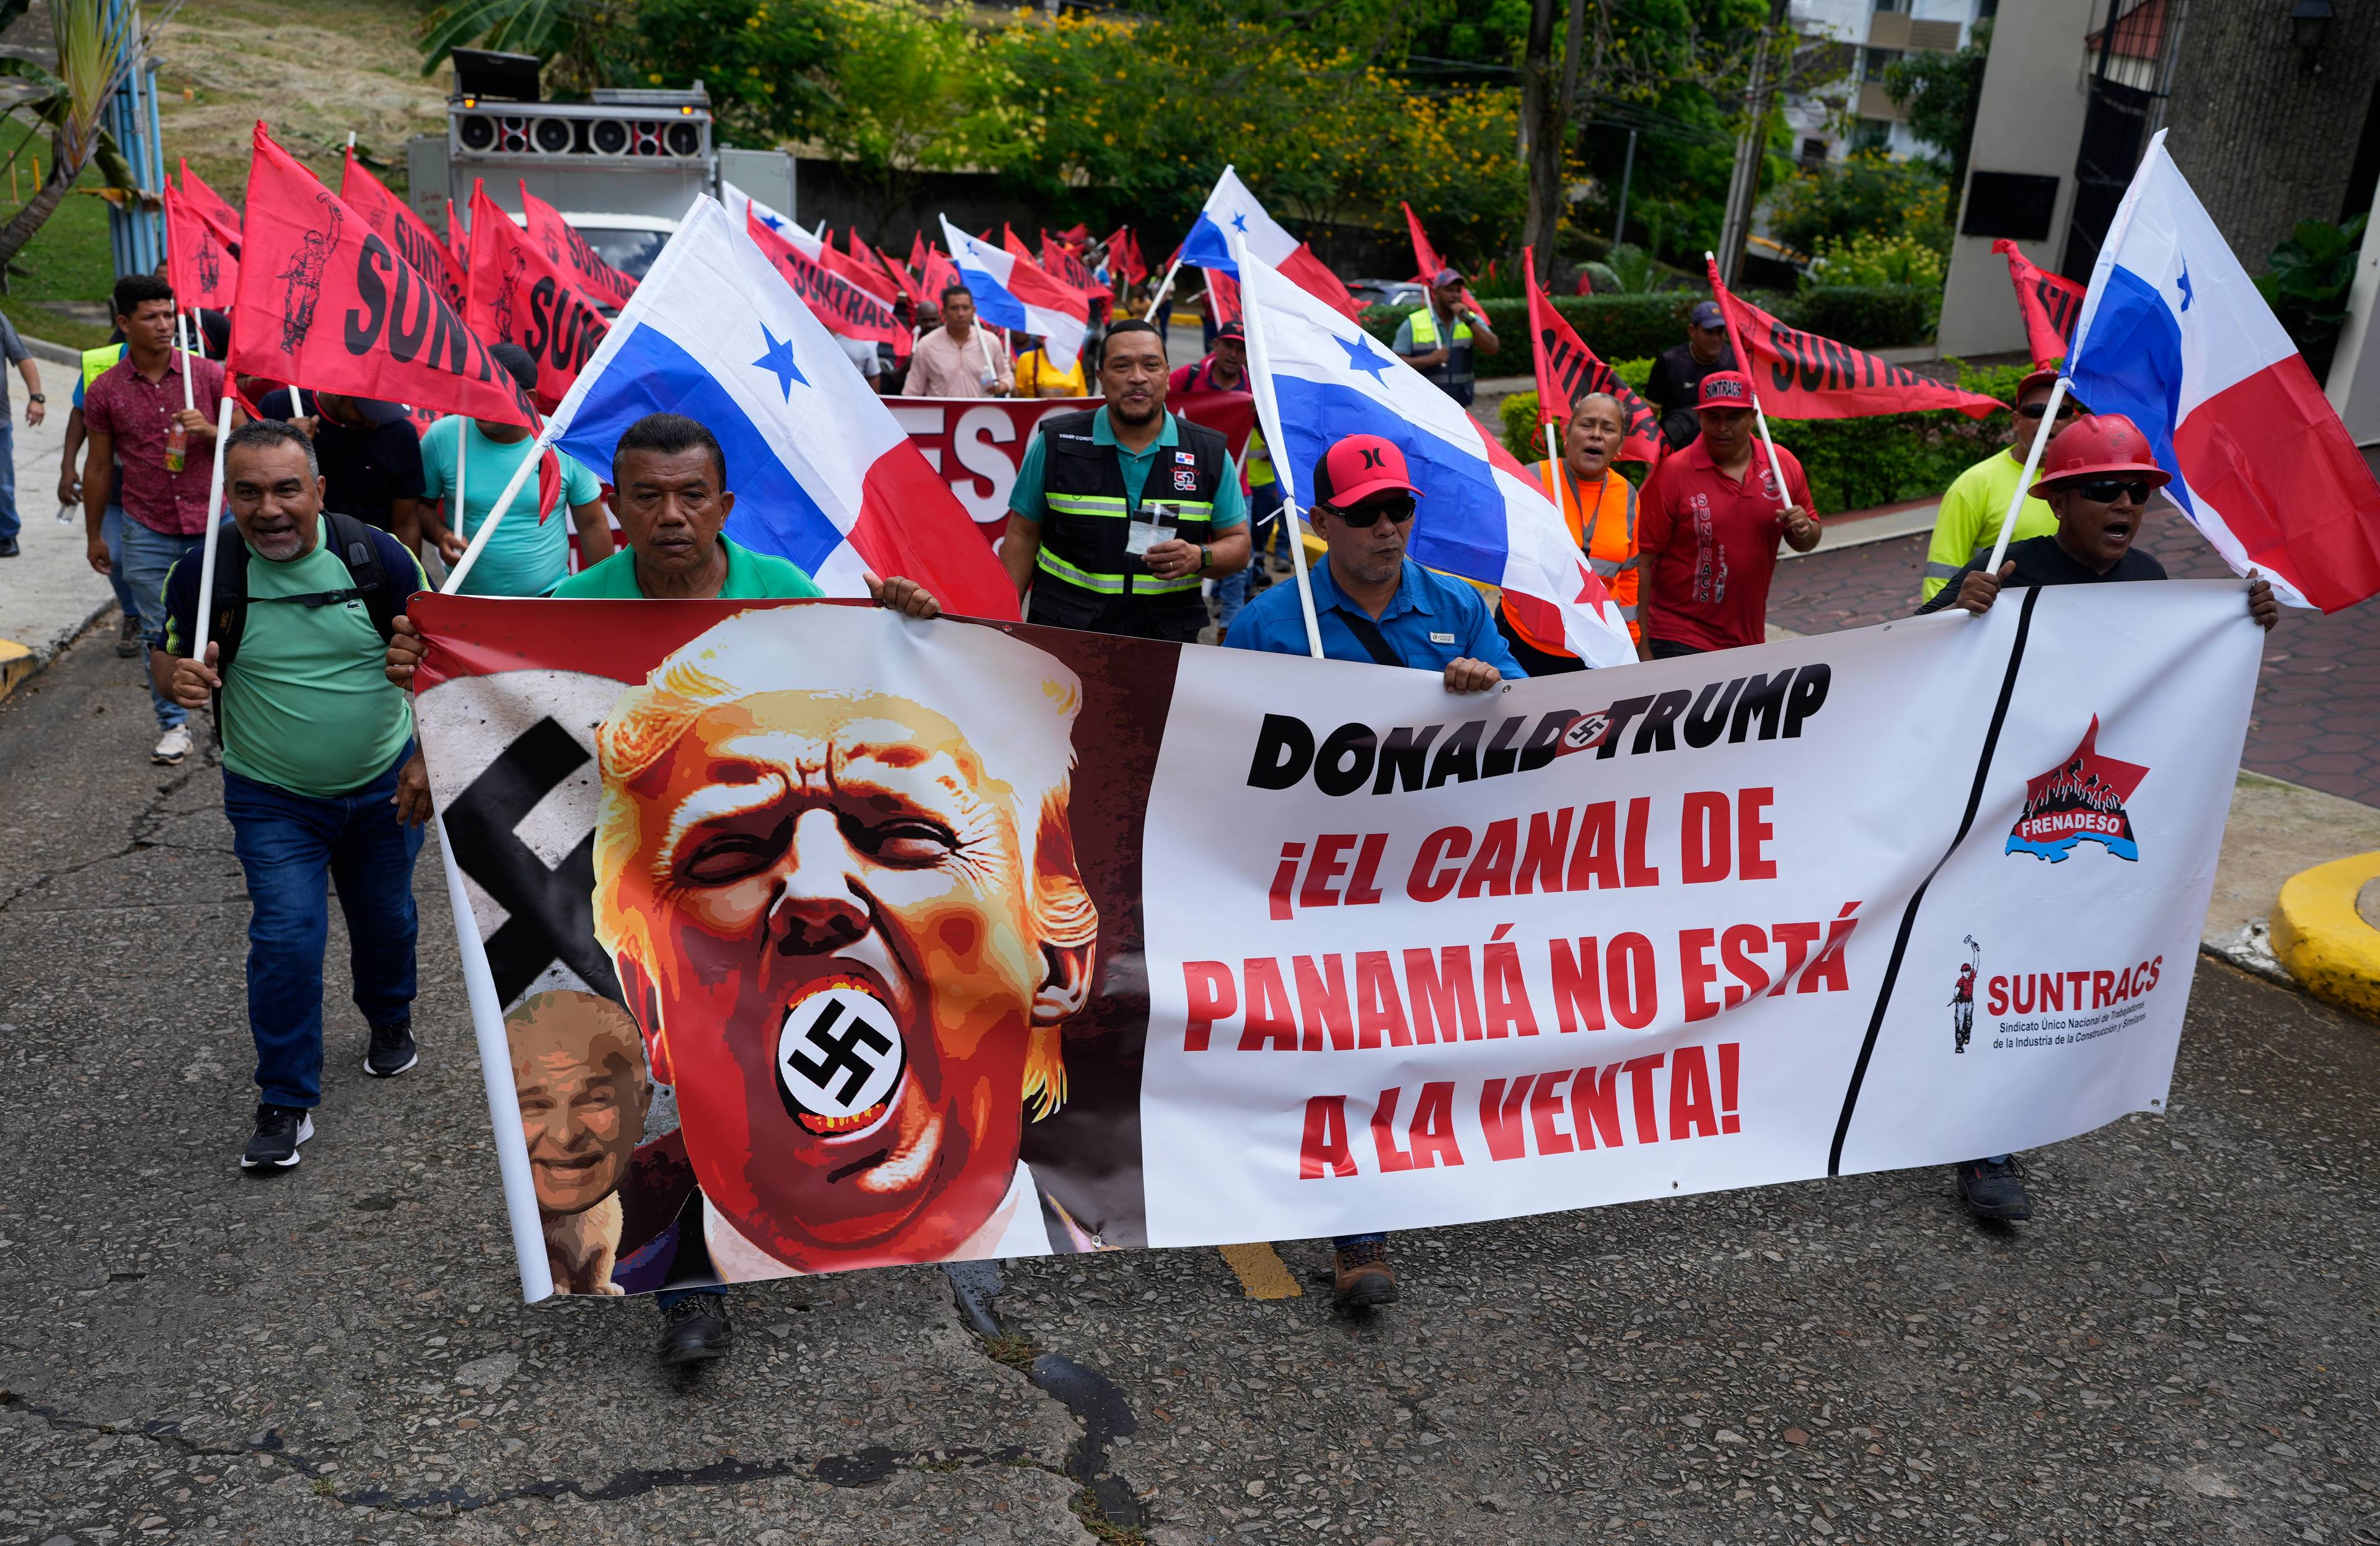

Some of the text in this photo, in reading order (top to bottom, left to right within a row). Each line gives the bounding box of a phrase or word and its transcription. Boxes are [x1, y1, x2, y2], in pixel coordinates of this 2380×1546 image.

[1706, 380, 1742, 398] SUNTRACS
[1697, 493, 1712, 602] SUNTRACS
[1246, 663, 1831, 797] DONALD TRUMP
[1269, 787, 1777, 921] ¡EL CANAL DE
[2022, 814, 2120, 837] FRENADESO
[1182, 900, 1862, 1052] PANAMÁ NO ESTÁ
[1987, 955, 2162, 1016] SUNTRACS
[1993, 1039, 2003, 1048] de
[2006, 1038, 2013, 1048] la
[2016, 1035, 2053, 1047] Industria
[2055, 1034, 2065, 1044] de
[2067, 1034, 2074, 1043] la
[2076, 1023, 2117, 1042] Construcción
[1999, 1021, 2039, 1033] Sindicato
[2042, 1017, 2066, 1030] Único
[2068, 1015, 2100, 1028] Nacional
[2101, 1014, 2109, 1022] de
[1299, 1043, 1740, 1179] A LA VENTA!
